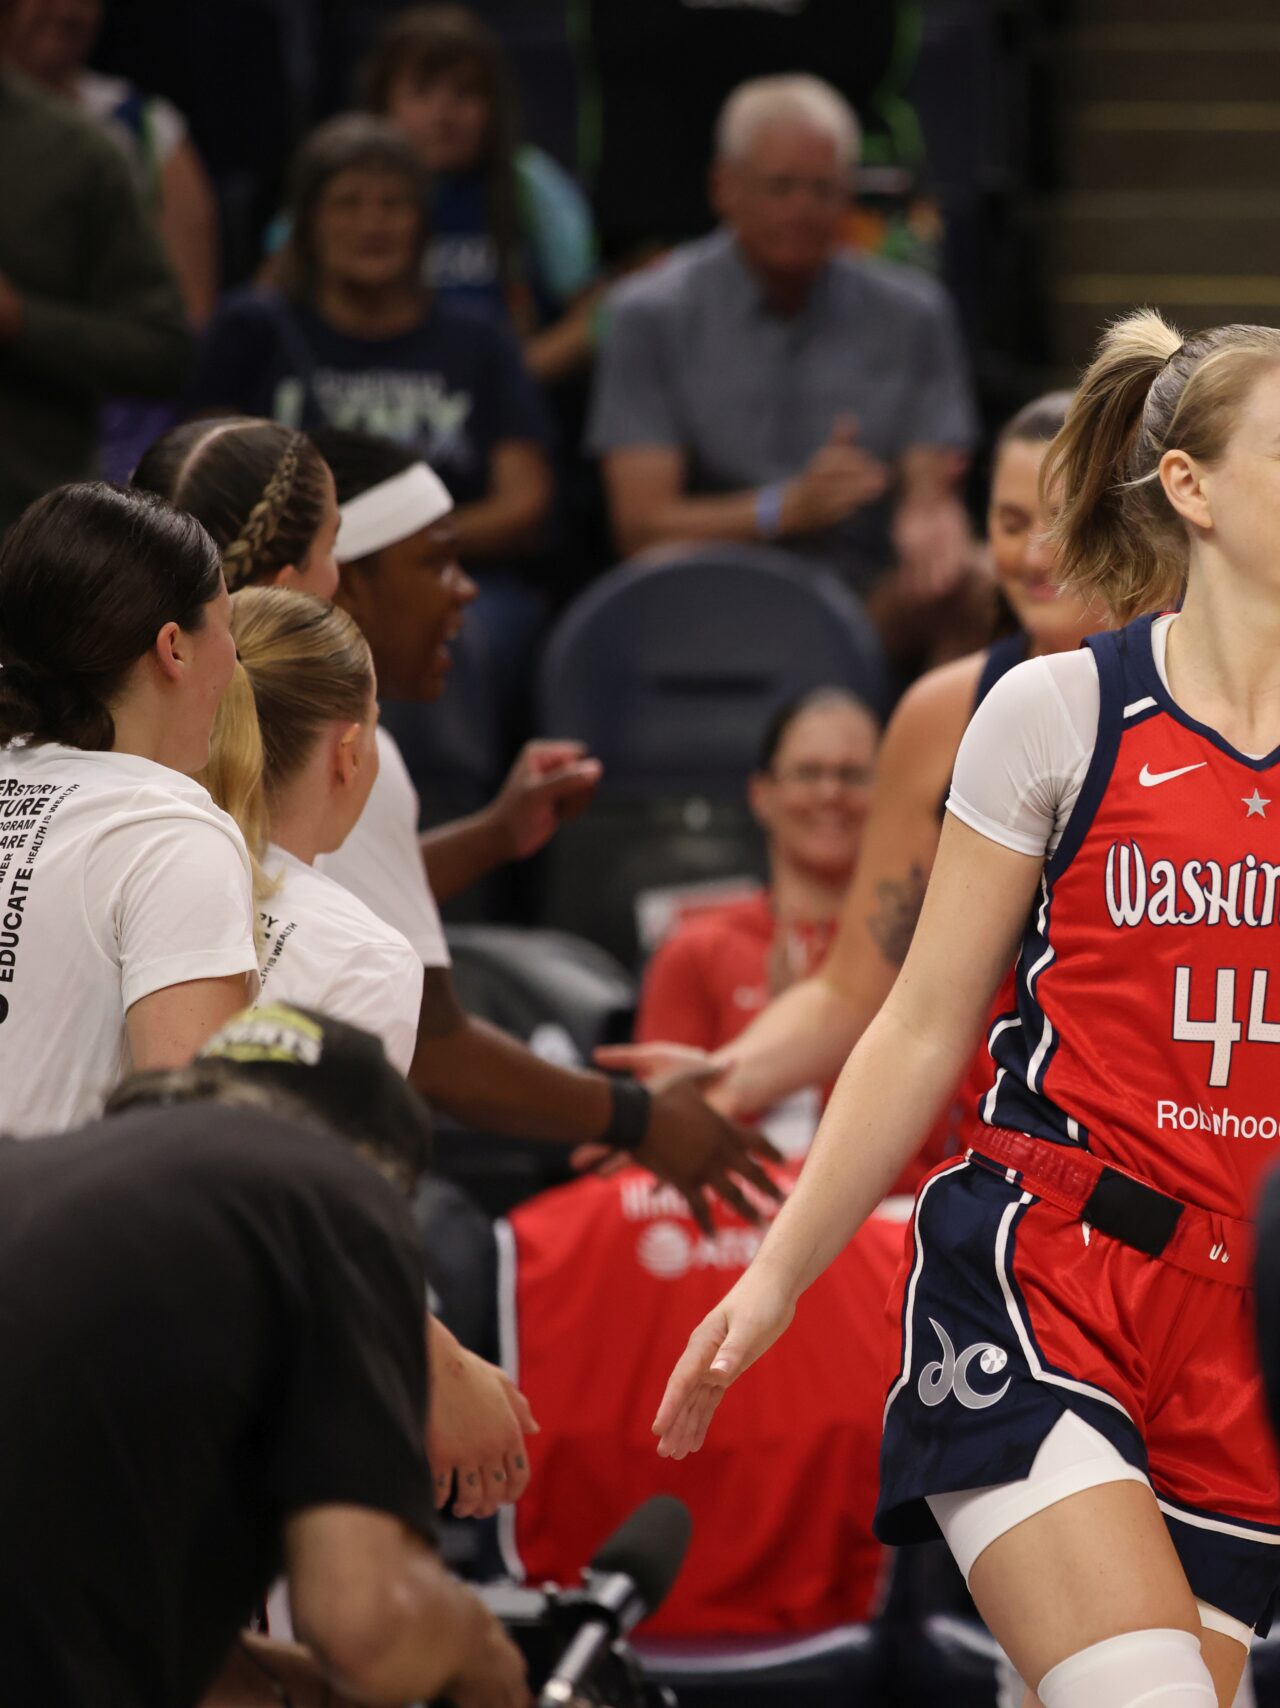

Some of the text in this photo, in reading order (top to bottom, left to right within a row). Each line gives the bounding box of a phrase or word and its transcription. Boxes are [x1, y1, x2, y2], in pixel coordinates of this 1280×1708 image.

[0, 820, 36, 831] GRAM
[26, 826, 47, 864] HEALTH
[48, 783, 80, 813] WEALTH
[0, 868, 33, 982] EDUCATE
[272, 922, 298, 956] WEALTH
